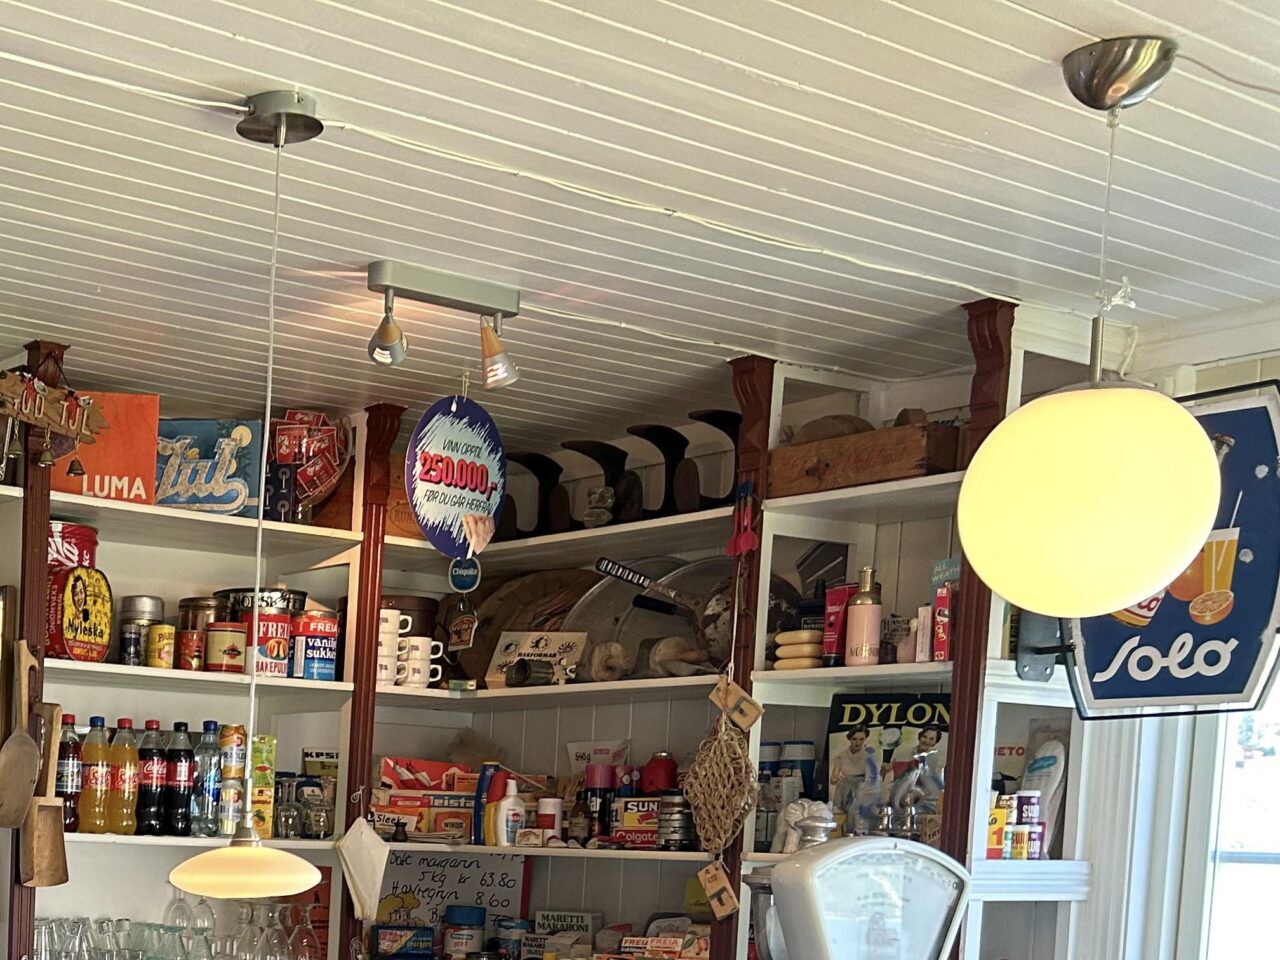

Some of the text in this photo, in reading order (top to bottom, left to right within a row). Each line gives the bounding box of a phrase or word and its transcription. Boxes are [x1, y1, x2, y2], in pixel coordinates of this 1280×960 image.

[442, 439, 461, 455] VINN
[82, 473, 148, 501] LUMA
[423, 489, 439, 503] FØR
[439, 492, 451, 506] DU
[450, 493, 465, 510] GÅR
[452, 567, 478, 577] Chiquita
[931, 567, 960, 583] WEATH
[933, 561, 948, 573] ALL
[65, 617, 104, 640] Nyleska
[258, 621, 289, 639] FREI
[309, 622, 337, 633] FREIA
[307, 637, 336, 649] vanilj
[307, 648, 336, 659] sukke
[1092, 632, 1240, 683] Solo
[256, 660, 289, 674] BAKEPUL
[838, 702, 950, 725] DYLON
[480, 871, 517, 889] 63.80
[475, 891, 510, 908] 8.60
[541, 912, 585, 924] MARETTI
[537, 923, 589, 933] MAKARONI
[649, 938, 679, 946] FREIA
